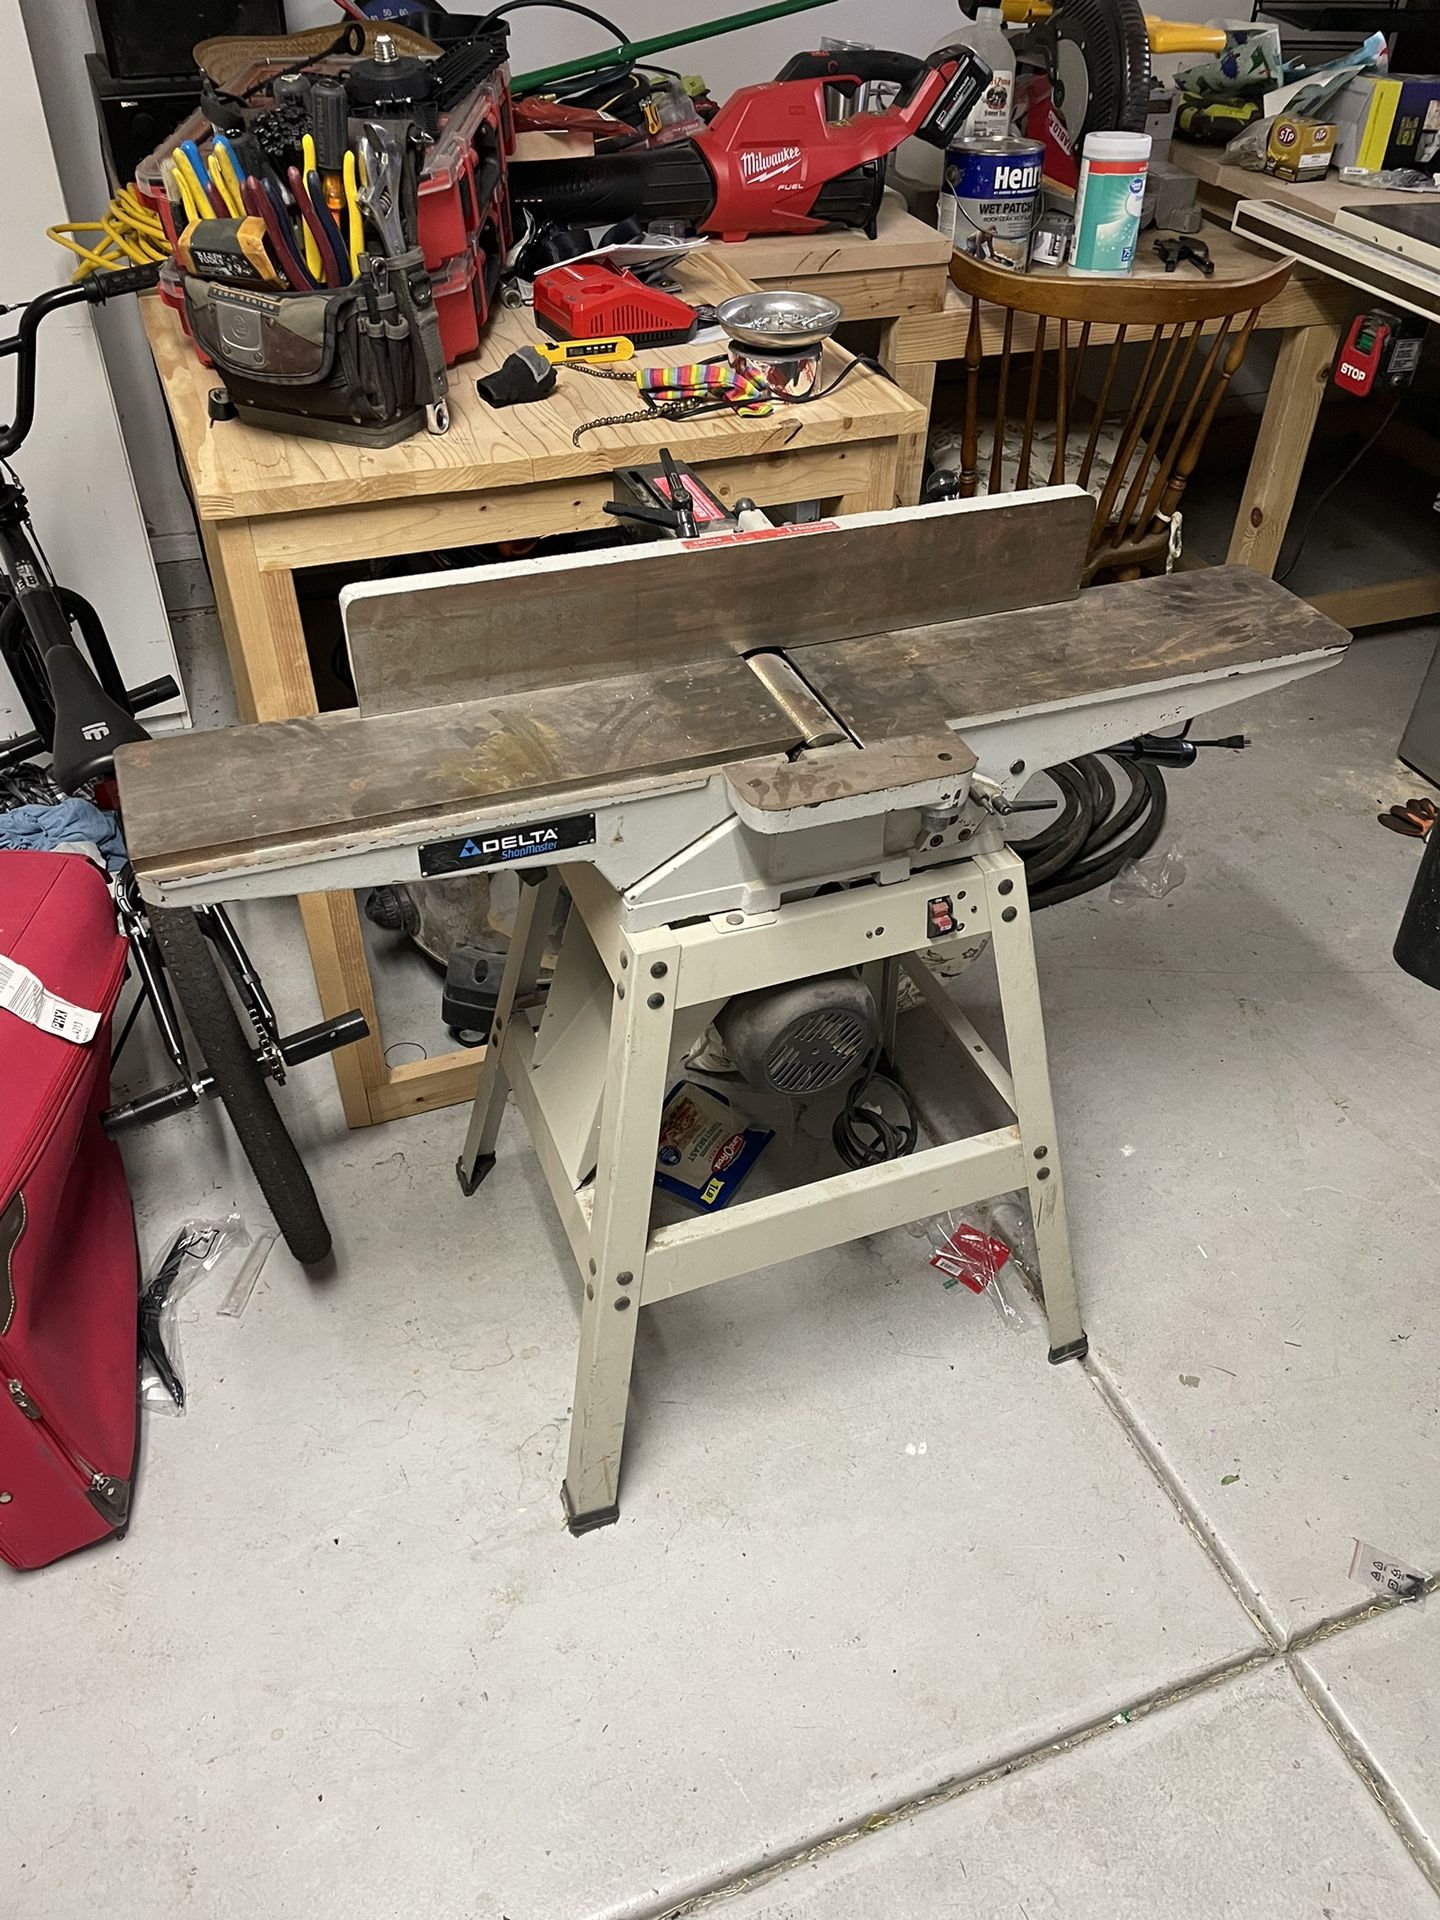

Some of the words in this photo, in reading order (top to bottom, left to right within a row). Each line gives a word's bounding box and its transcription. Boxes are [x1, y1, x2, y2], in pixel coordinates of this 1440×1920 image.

[382, 8, 392, 17] 50
[1052, 122, 1073, 151] IABLO
[1279, 127, 1295, 142] STP
[1315, 130, 1327, 140] STP
[740, 146, 801, 177] Milwaukee
[994, 165, 1042, 190] Henr
[979, 203, 1002, 215] WET
[1003, 201, 1033, 213] PATCH
[1340, 362, 1366, 381] STOP
[482, 828, 558, 853] DELTA
[501, 841, 558, 860] ShopMaster
[52, 1009, 68, 1031] PHX
